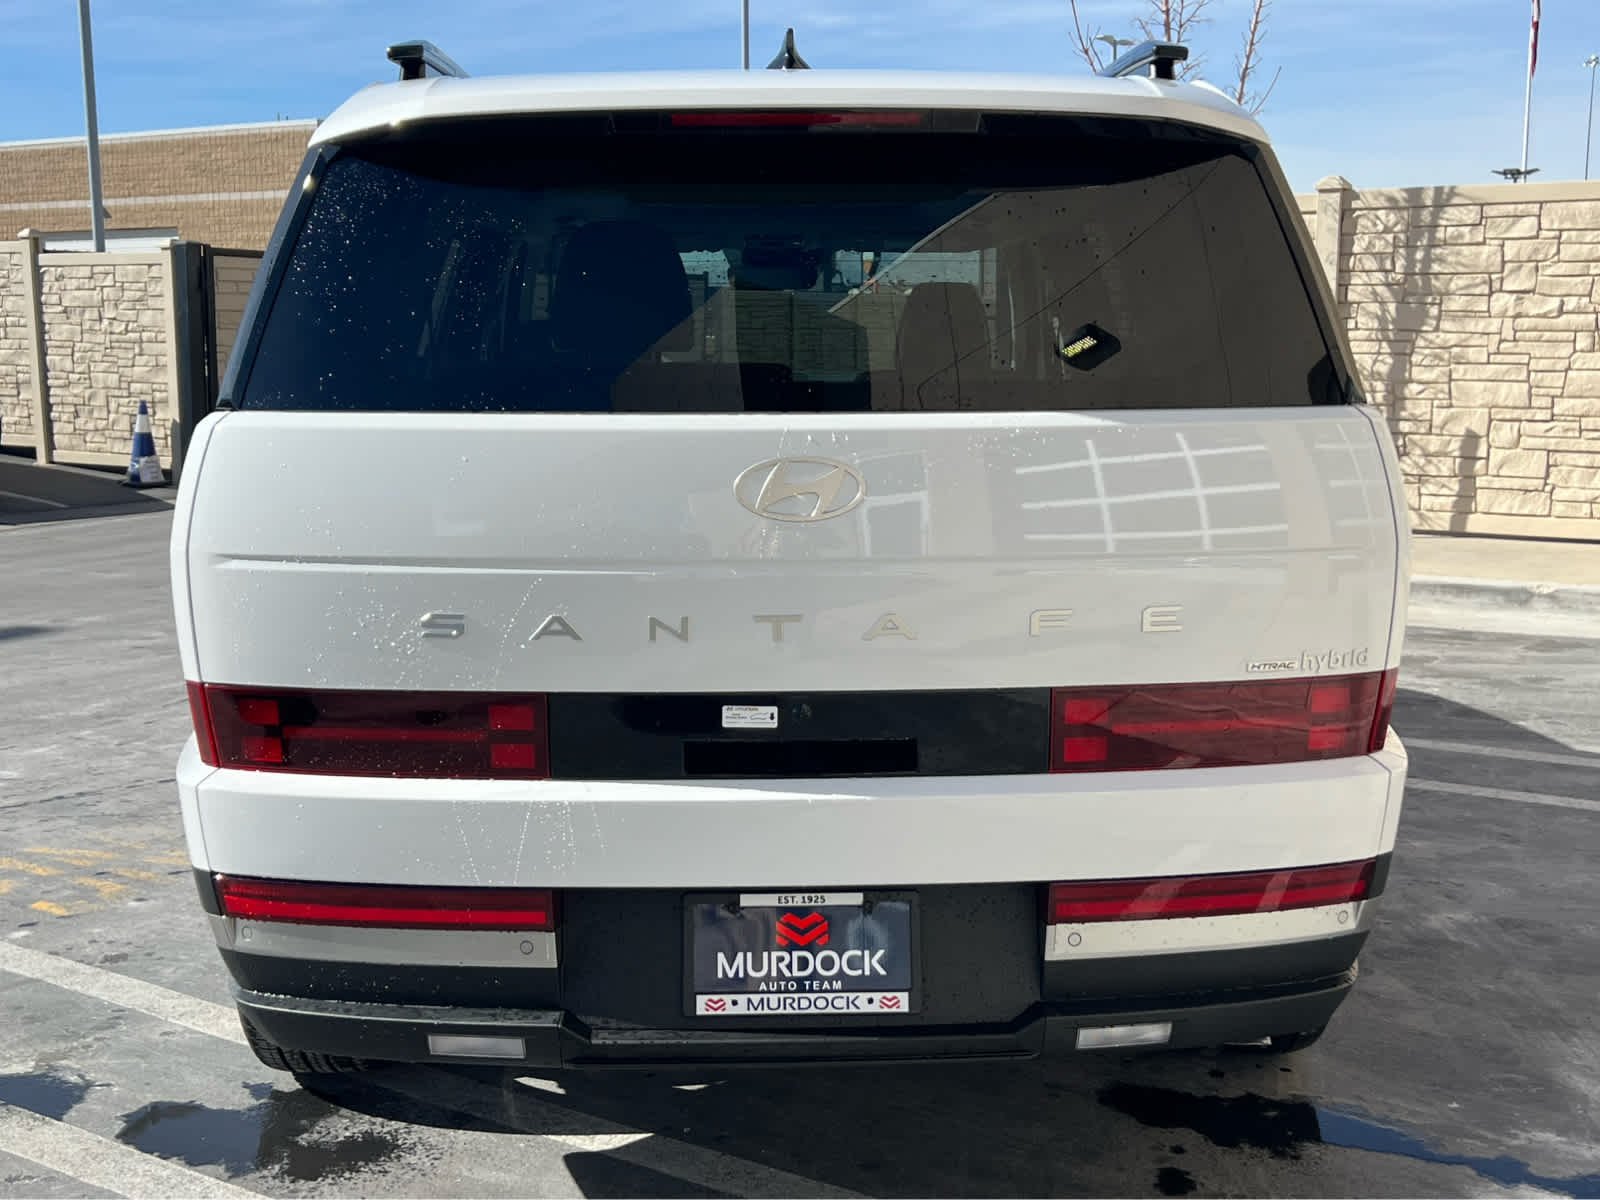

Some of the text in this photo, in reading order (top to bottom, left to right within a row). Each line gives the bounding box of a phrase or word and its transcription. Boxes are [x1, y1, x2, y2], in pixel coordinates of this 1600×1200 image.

[420, 604, 1184, 642] SANTA FE
[1248, 647, 1369, 673] HTRAC hybrid
[777, 895, 826, 905] EST. 1925
[717, 949, 888, 979] MURDOCK
[758, 980, 843, 992] AUTO TEAM
[746, 995, 861, 1012] MURDOCK
